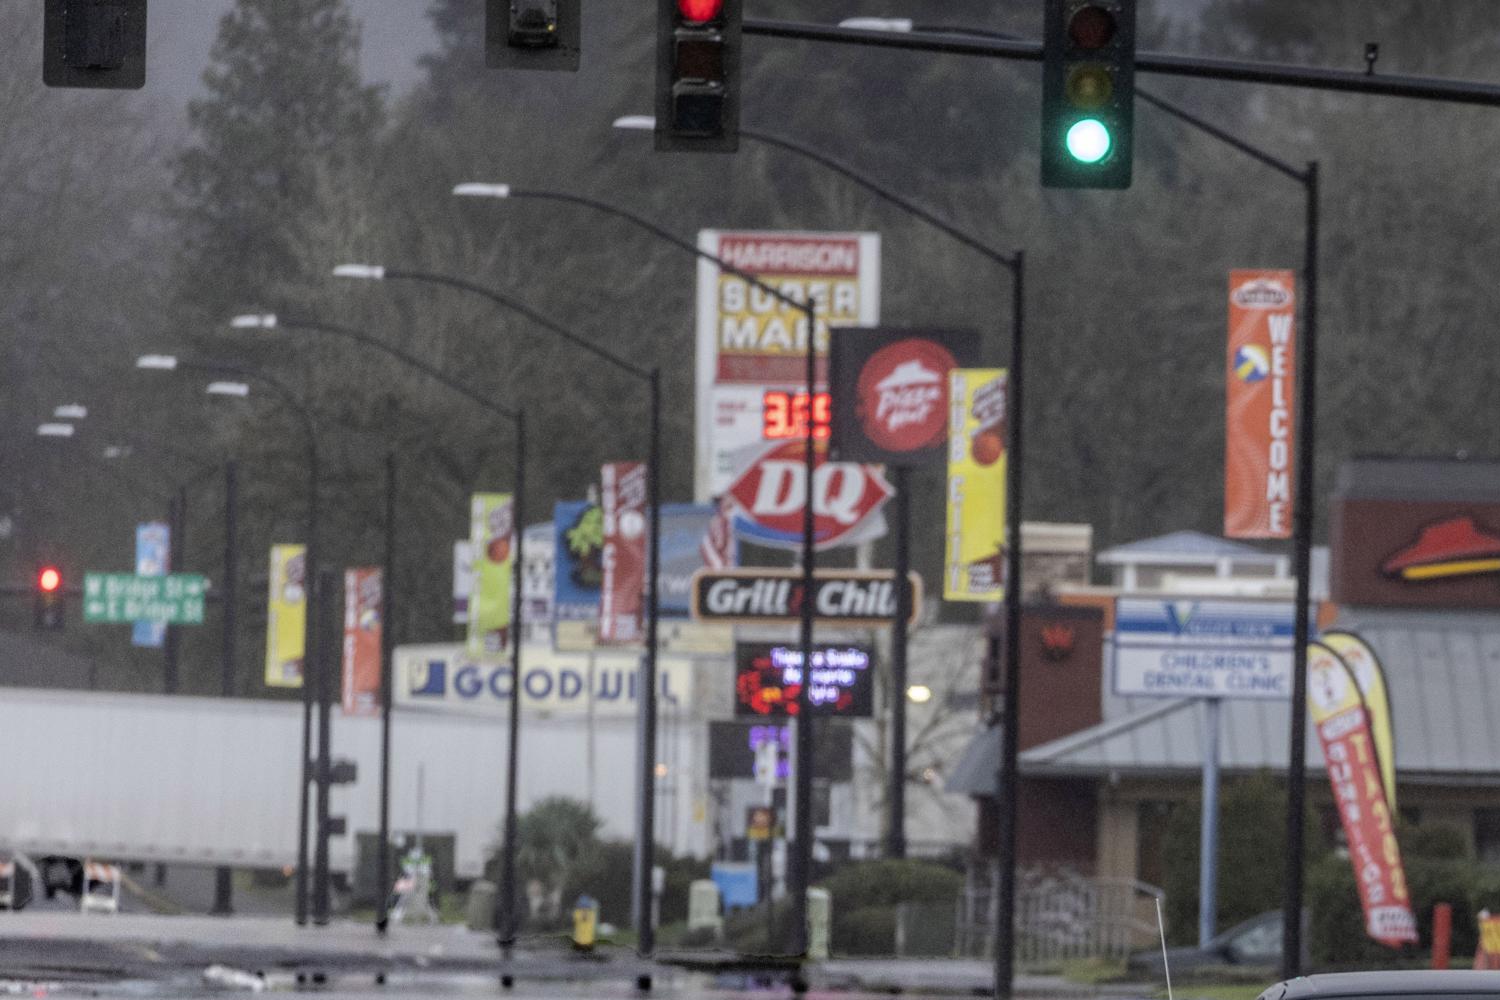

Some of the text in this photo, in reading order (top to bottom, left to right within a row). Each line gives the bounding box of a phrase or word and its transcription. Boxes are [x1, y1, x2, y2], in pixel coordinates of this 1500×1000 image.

[721, 241, 855, 271] HARRISON
[1266, 313, 1293, 533] WELCOME
[752, 461, 867, 524] DQ
[706, 578, 791, 615] Grill
[816, 580, 898, 617] Chil
[454, 665, 678, 703] GOODWIL
